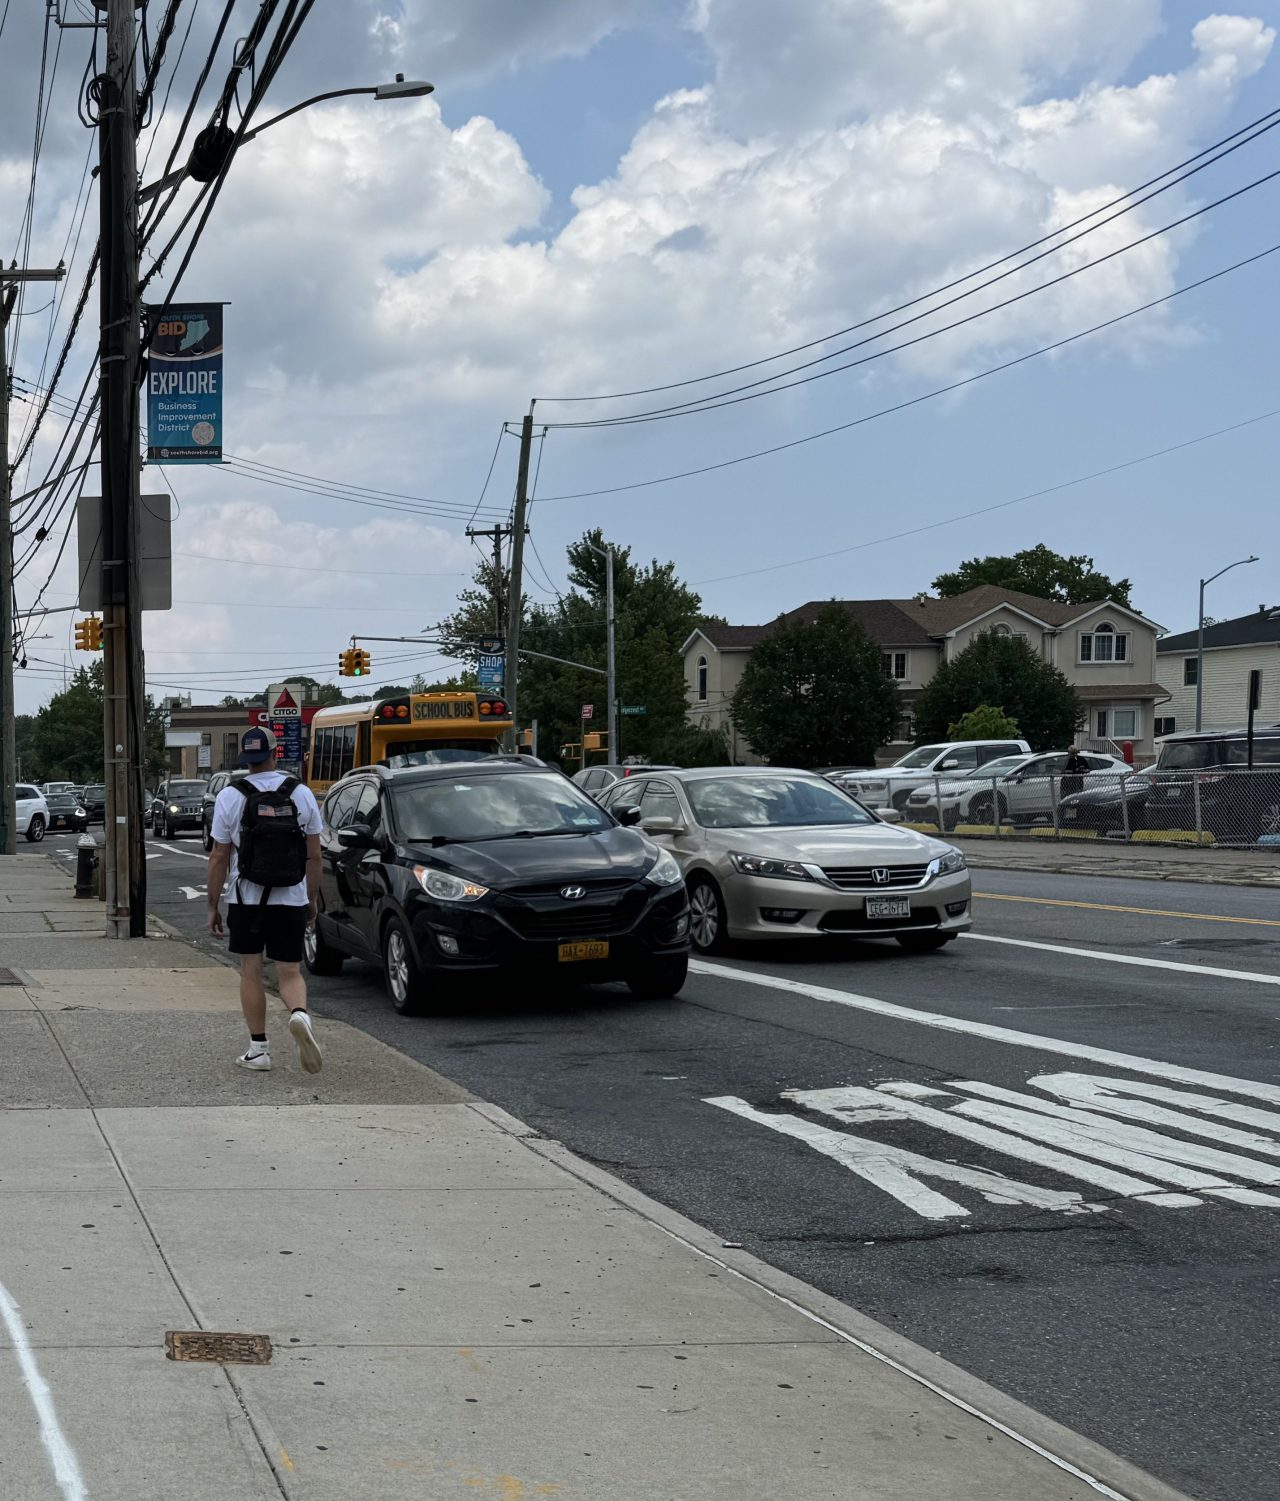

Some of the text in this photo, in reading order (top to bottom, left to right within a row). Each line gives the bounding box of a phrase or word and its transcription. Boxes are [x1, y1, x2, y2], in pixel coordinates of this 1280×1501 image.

[159, 314, 181, 322] OUTH
[157, 321, 187, 337] BID
[150, 371, 217, 395] EXPLORE
[158, 402, 197, 410] Business
[158, 412, 216, 422] Improvement
[158, 424, 190, 432] District
[480, 656, 502, 668] SHOP
[273, 708, 298, 716] CITGO
[415, 702, 473, 719] SCHOOL BUS
